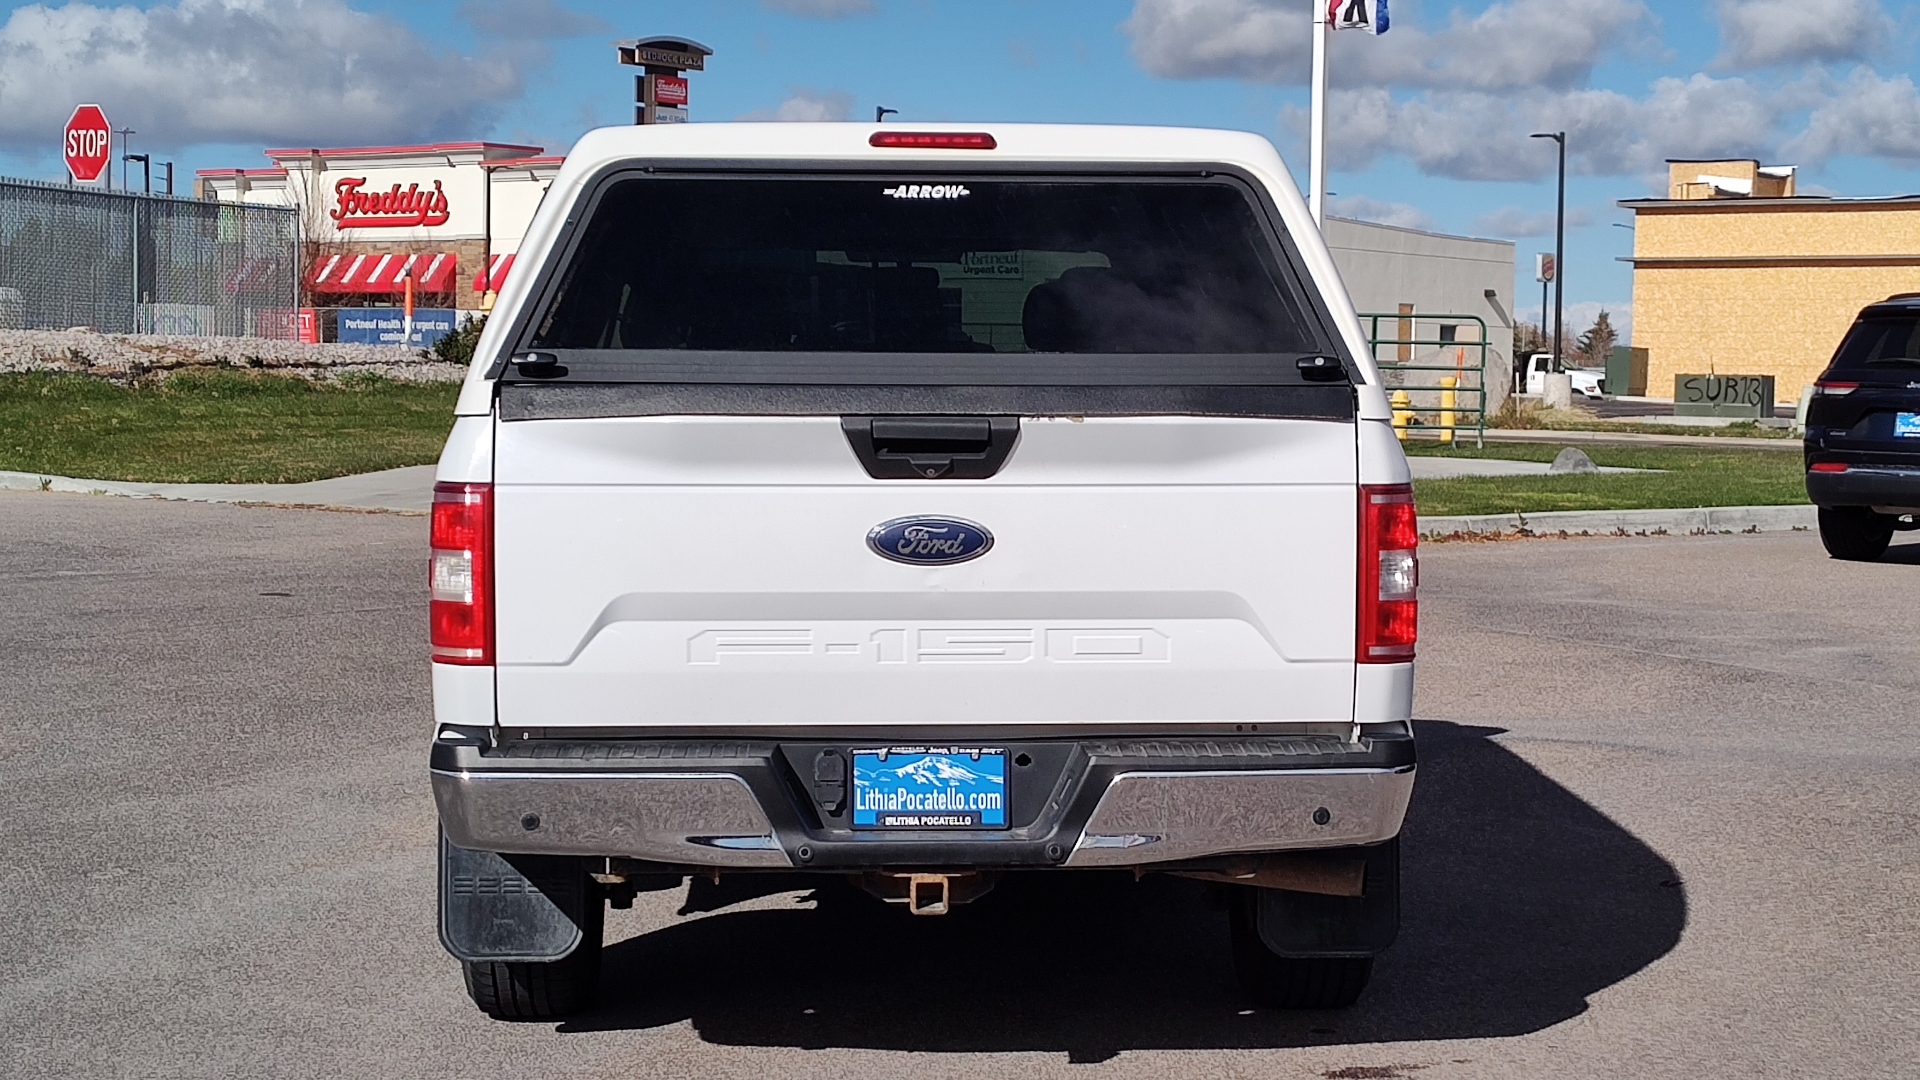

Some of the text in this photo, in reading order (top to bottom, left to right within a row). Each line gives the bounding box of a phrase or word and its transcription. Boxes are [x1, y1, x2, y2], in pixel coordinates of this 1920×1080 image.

[679, 55, 702, 67] PLAZA
[67, 129, 107, 158] STOP
[892, 184, 965, 199] ARROW
[329, 176, 451, 231] Freddy's
[963, 265, 1020, 275] Urgent Care
[345, 319, 377, 329] Portneuf
[378, 319, 401, 329] Health
[415, 320, 436, 332] urgent
[436, 321, 449, 331] care
[379, 331, 406, 343] coming
[897, 525, 966, 556] Ford
[686, 628, 1172, 665] F-150
[856, 787, 1001, 811] LithiaPocatello.com
[893, 816, 972, 826] LITHIA POCATELLO
